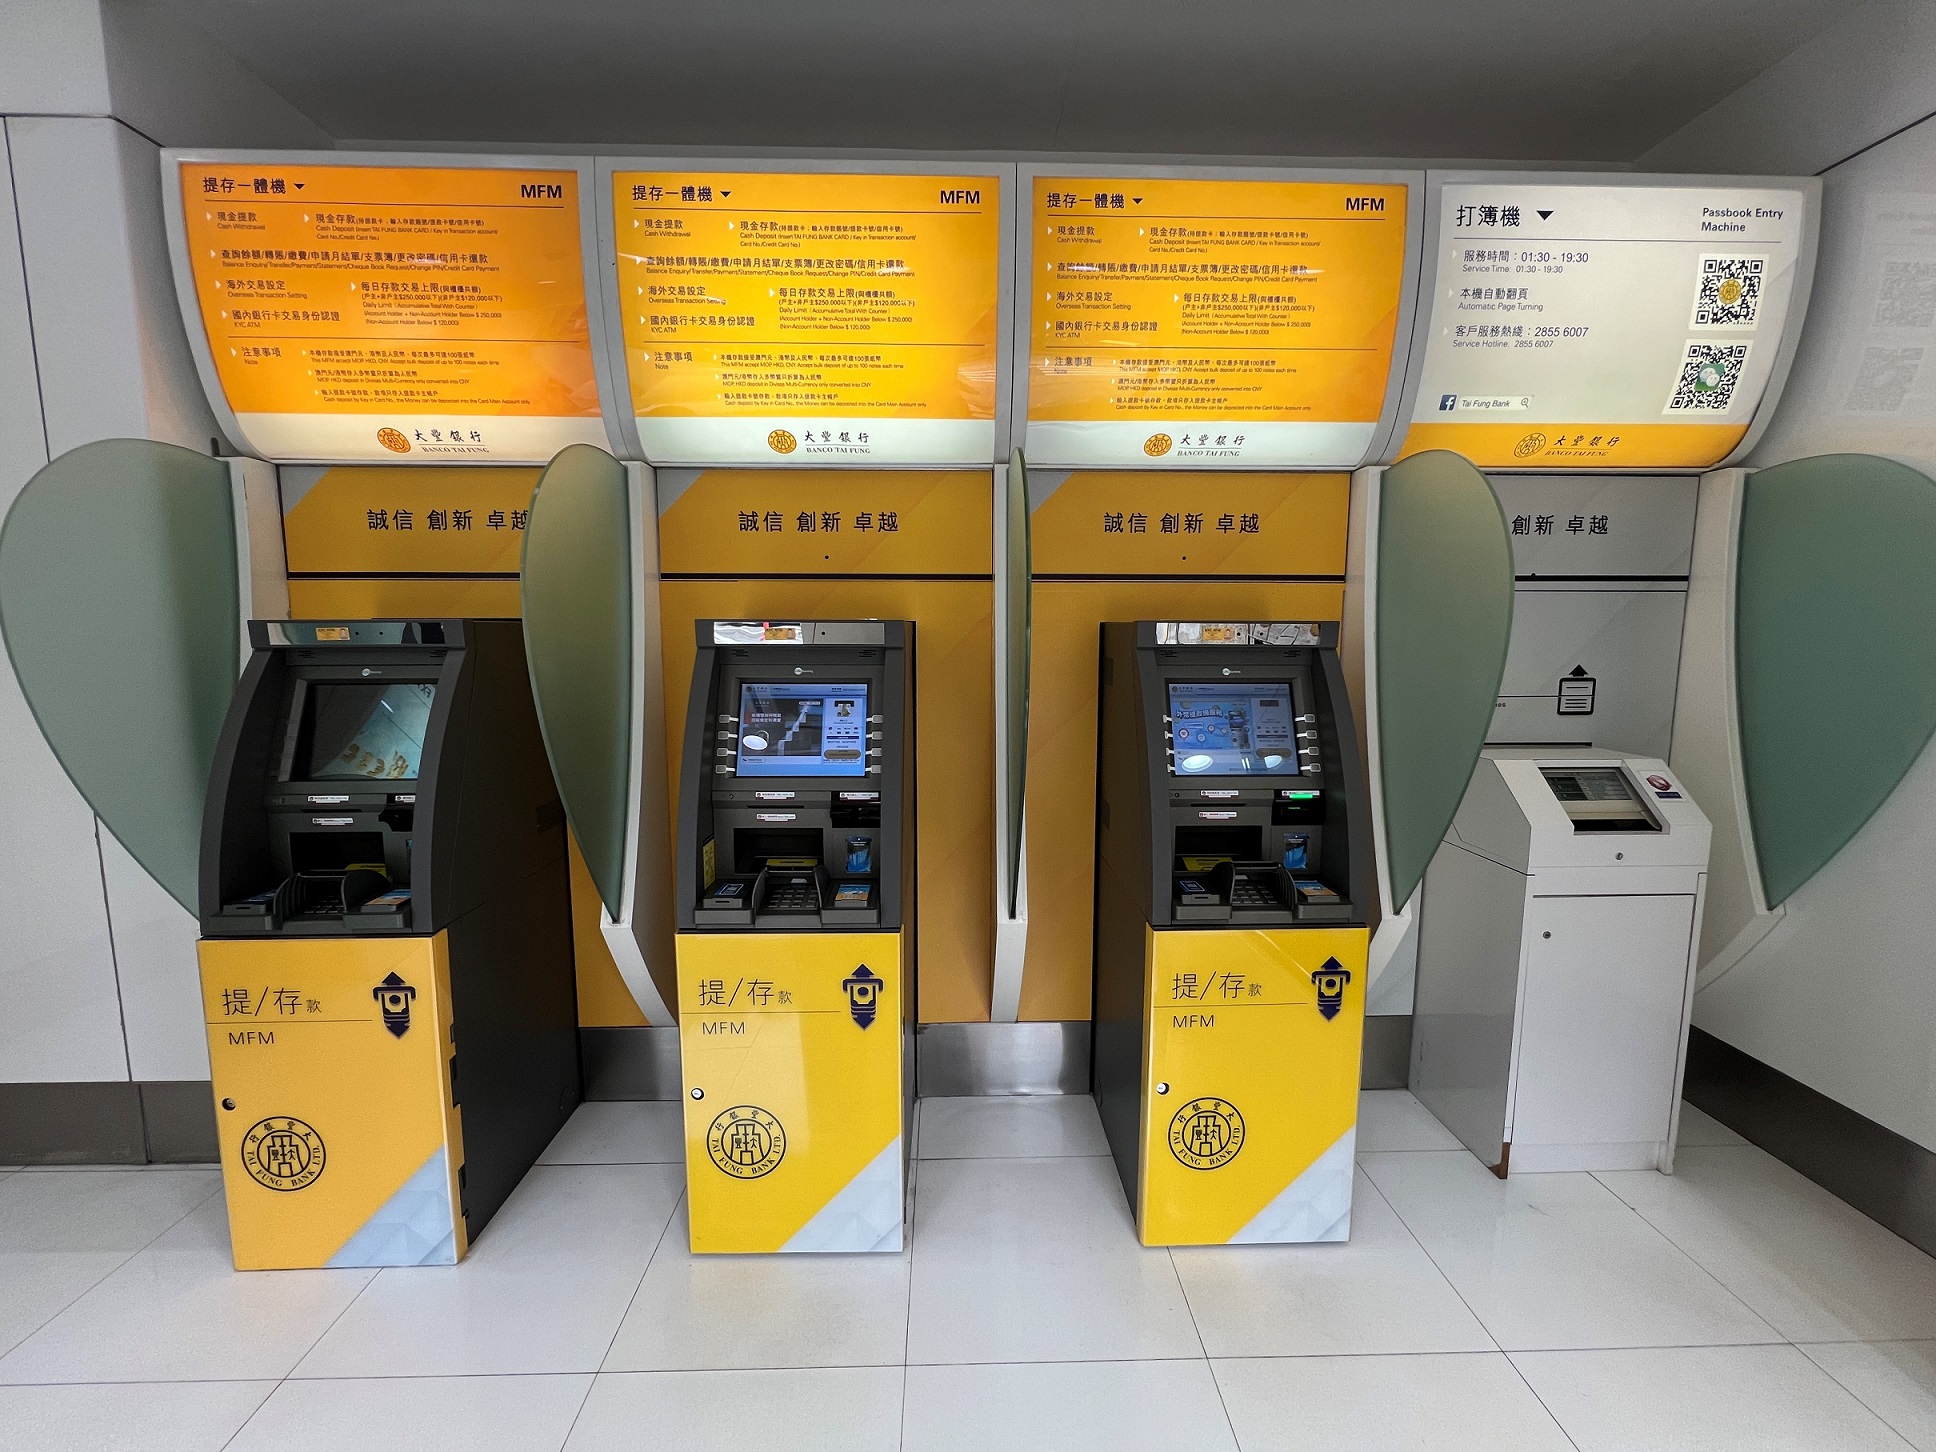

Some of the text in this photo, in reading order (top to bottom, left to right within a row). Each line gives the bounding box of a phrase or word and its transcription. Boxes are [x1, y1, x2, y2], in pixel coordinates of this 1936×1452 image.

[203, 177, 286, 194] 提存一體機
[520, 183, 563, 200] MFM
[632, 185, 713, 202] 提存一體機
[940, 190, 981, 205] MFM
[1046, 193, 1125, 209] 提存一體機
[1345, 197, 1385, 212] MFM
[217, 211, 258, 222] 現金提款
[1455, 205, 1520, 228] 打簿機
[1702, 207, 1784, 219] Passbook Entry
[644, 219, 684, 230] 現金提款
[1057, 225, 1095, 236] 現金提款
[1701, 221, 1746, 232] Machine
[1560, 252, 1589, 263] 19:30
[1462, 264, 1491, 272] Service
[1491, 264, 1511, 273] Time:
[1515, 265, 1536, 274] 01:30
[1543, 265, 1564, 274] 19:30
[227, 280, 286, 290] 海外交易設定
[648, 286, 706, 296] 海外交易設定
[1056, 291, 1112, 302] 海外交易設定
[1460, 287, 1529, 301] 本機自動翻頁
[1457, 303, 1543, 313] Automatic Page Turning
[1563, 326, 1589, 338] 6007
[1452, 340, 1554, 348] Service Hotline: 2855 6007
[241, 347, 282, 358] 注意事項
[654, 351, 693, 362] 注意事項
[1054, 357, 1092, 367] 注意事項
[1472, 400, 1490, 409] Fung
[366, 508, 414, 532] 誠信
[426, 508, 473, 532] 創新
[738, 510, 899, 533] 誠信 創新 卓越
[1103, 512, 1260, 534] 誠信 創新 卓越
[1511, 514, 1609, 536] 創新 卓越
[702, 1021, 746, 1035] MFM
[1172, 1014, 1215, 1028] MFM
[228, 1031, 275, 1045] MFM
[1172, 1130, 1181, 1145] TAI
[1178, 1148, 1202, 1166] FUNG
[1209, 1148, 1233, 1165] BANK
[711, 1138, 721, 1153] TAI
[718, 1156, 744, 1175] FUNG
[751, 1157, 776, 1175] BANK
[246, 1150, 257, 1166] TAI
[256, 1168, 283, 1187] FUNG
[290, 1169, 316, 1187] BANK
